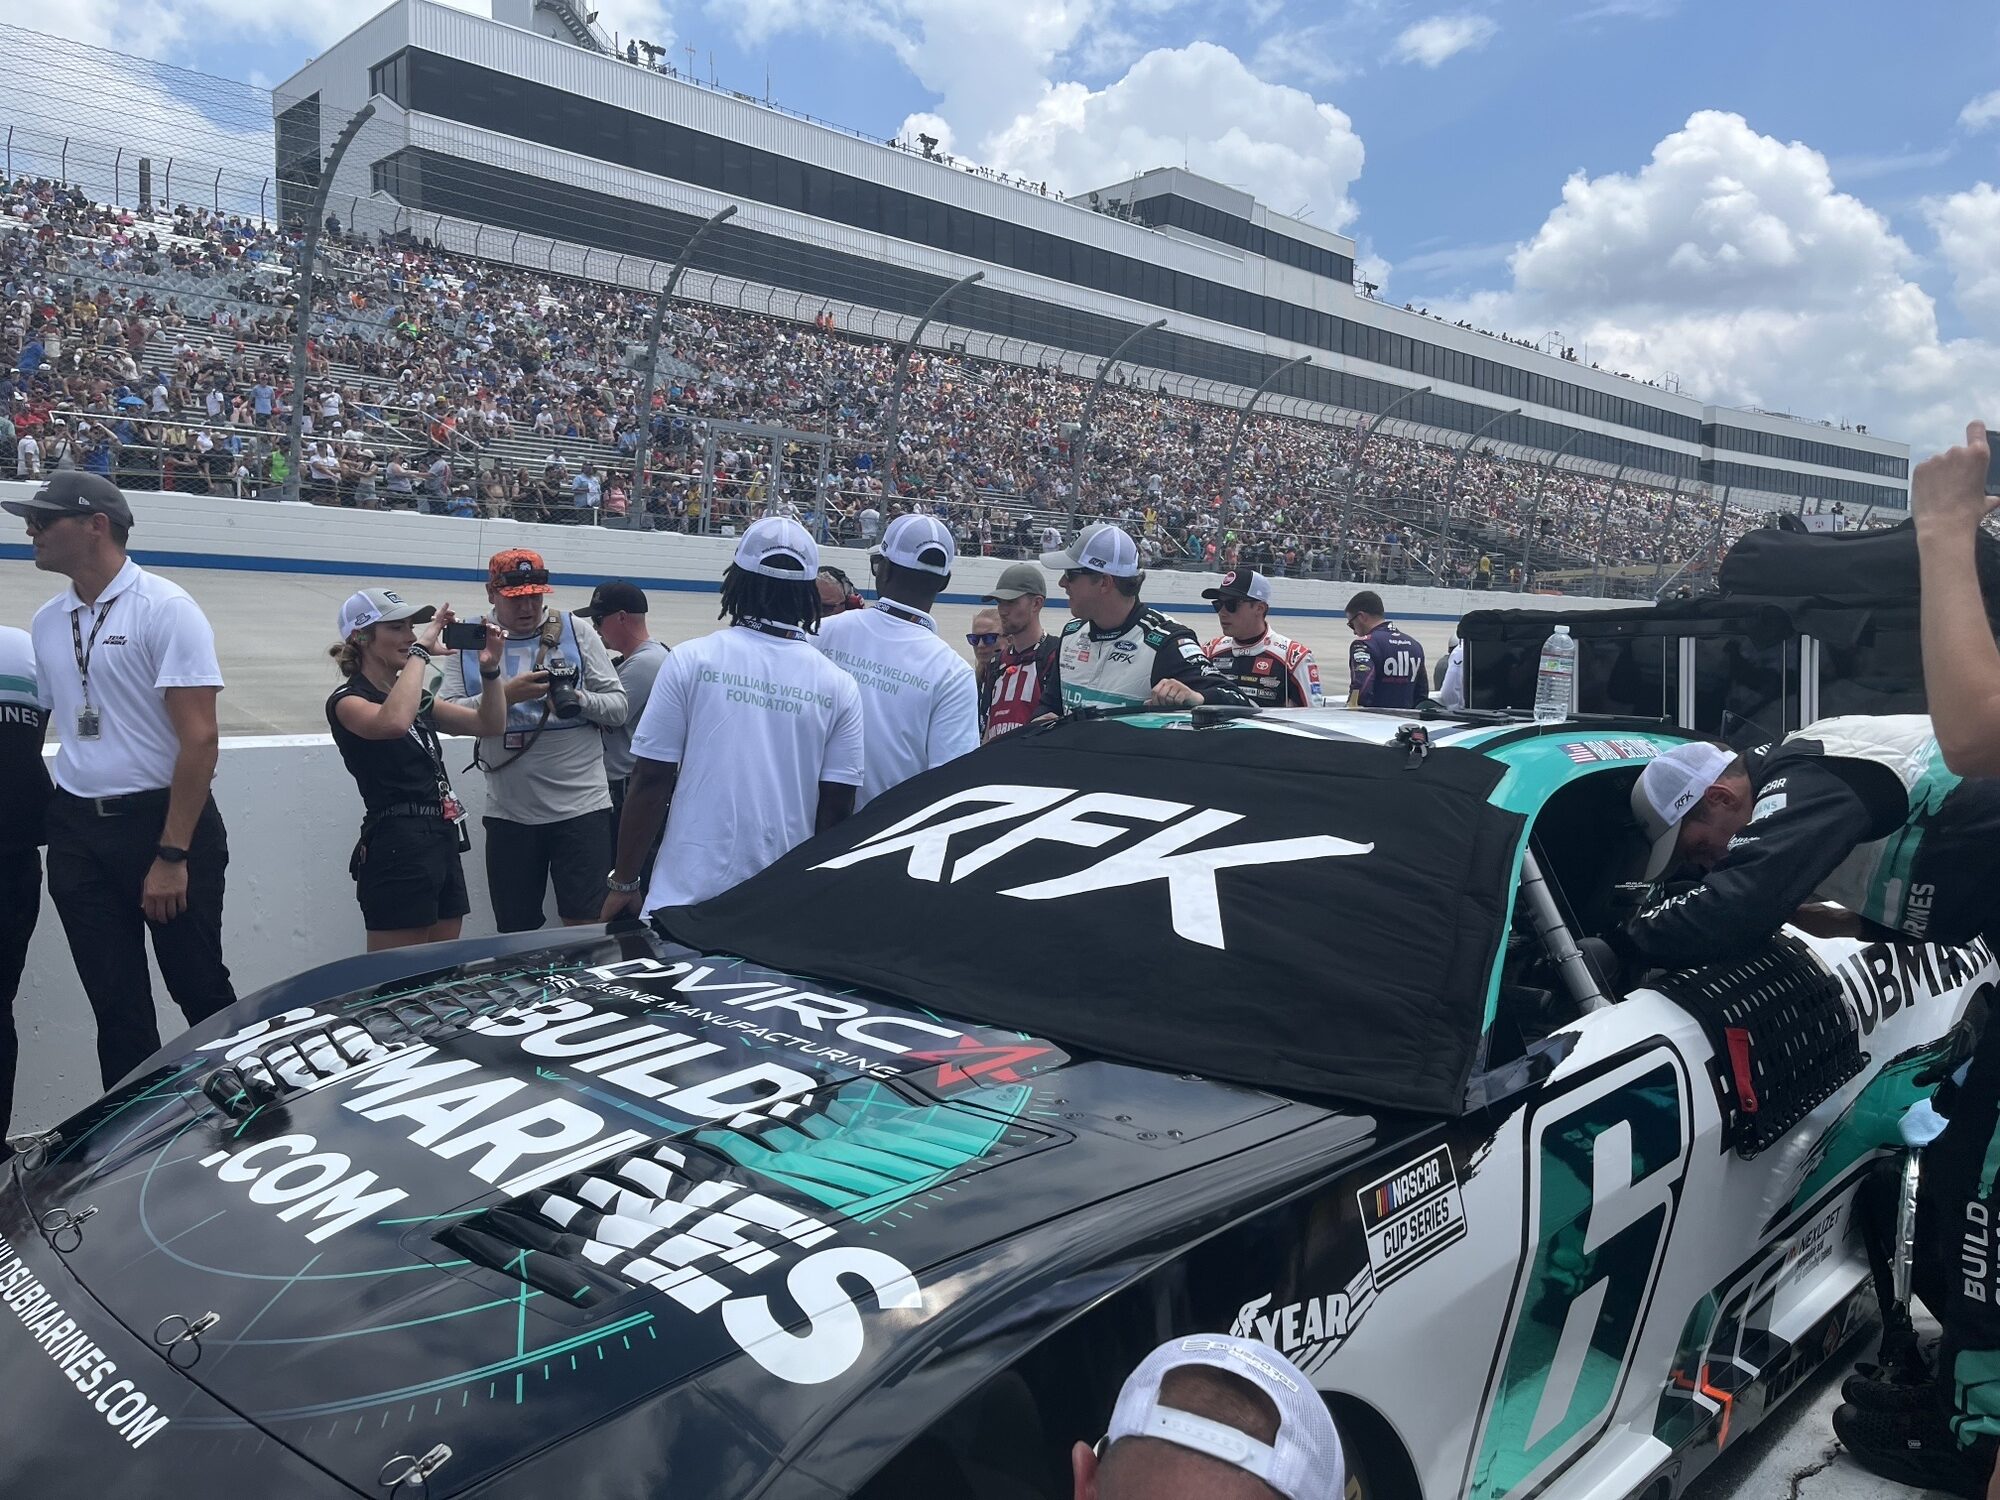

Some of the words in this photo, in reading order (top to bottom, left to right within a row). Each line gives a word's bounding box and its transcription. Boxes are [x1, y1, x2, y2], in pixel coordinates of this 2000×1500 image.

[834, 650, 882, 675] WILLIAMS
[882, 664, 931, 692] WELDING
[842, 667, 901, 696] UNDATION
[1108, 652, 1135, 665] RFK
[1383, 650, 1421, 683] ally
[697, 670, 720, 684] JOE
[721, 671, 778, 696] WILLIAMS
[779, 684, 833, 710] WELDING
[726, 688, 803, 716] FOUNDATION
[1674, 790, 1695, 811] RFK
[802, 784, 1374, 950] RFK
[470, 997, 828, 1119] BUILD
[657, 1000, 903, 1079] MANUFACTURING
[197, 1133, 410, 1245] .COM
[1391, 1157, 1442, 1209] NASCAR
[1383, 1220, 1408, 1259] CUP
[1409, 1196, 1450, 1243] SERIES
[1963, 1200, 1990, 1303] BUILD
[0, 1234, 171, 1450] UILDSUBMARINES.COM
[1254, 1292, 1352, 1353] YEAR
